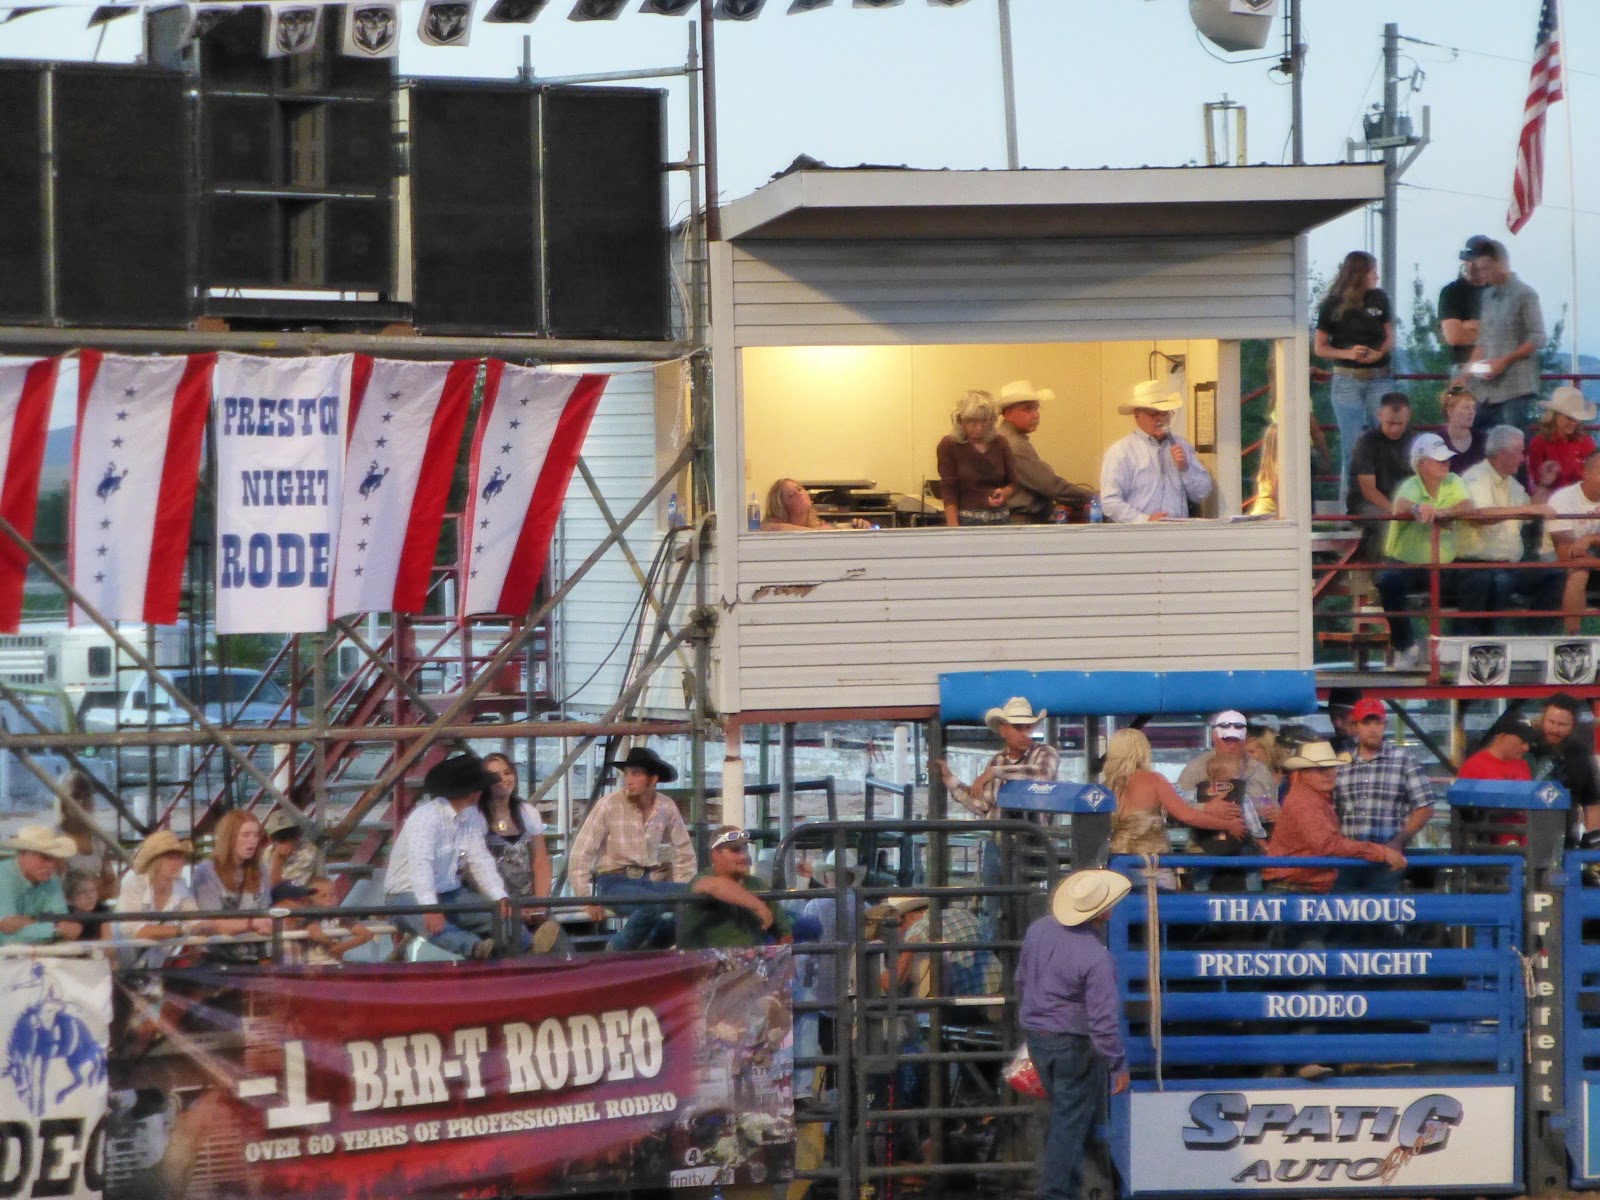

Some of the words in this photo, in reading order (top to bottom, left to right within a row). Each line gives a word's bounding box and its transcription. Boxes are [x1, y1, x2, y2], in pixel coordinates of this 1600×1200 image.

[1208, 898, 1287, 922] THAT
[1300, 898, 1417, 922] FAMOUS
[1199, 952, 1328, 977] PRESTON
[1340, 951, 1433, 976] NIGHT
[1265, 994, 1369, 1019] RODEO
[347, 1027, 489, 1112] BAR-T
[503, 1006, 665, 1095] RODEO
[244, 1137, 301, 1163] OVER
[307, 1134, 336, 1156] 60
[340, 1124, 409, 1151] YEARS
[414, 1121, 441, 1143] OF
[446, 1101, 601, 1138] PROFESSIONAL
[604, 1090, 678, 1119] RODEO
[1231, 1156, 1388, 1183] AUTO
